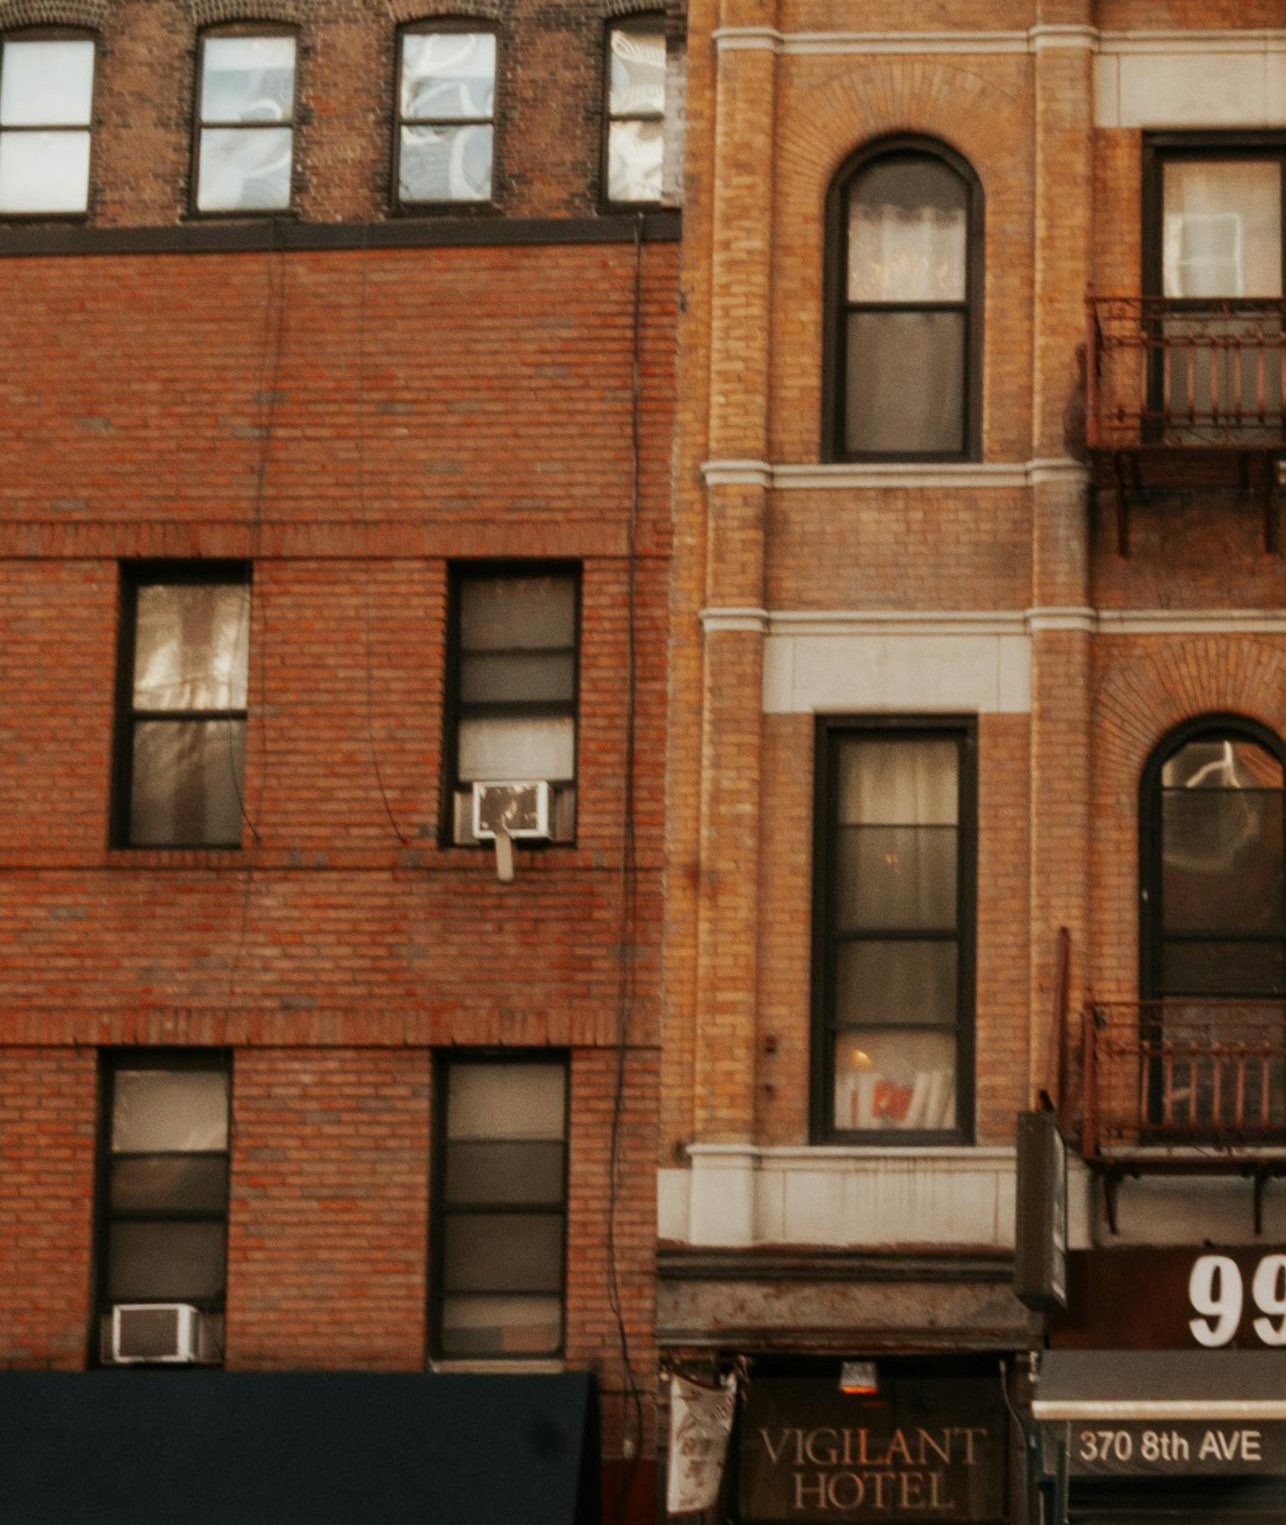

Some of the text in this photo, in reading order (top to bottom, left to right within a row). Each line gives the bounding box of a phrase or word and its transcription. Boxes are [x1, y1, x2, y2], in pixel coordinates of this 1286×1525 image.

[761, 1428, 987, 1465] VIGILANT
[1079, 1430, 1262, 1461] 370 8th AVE
[792, 1471, 955, 1510] HOTEL
